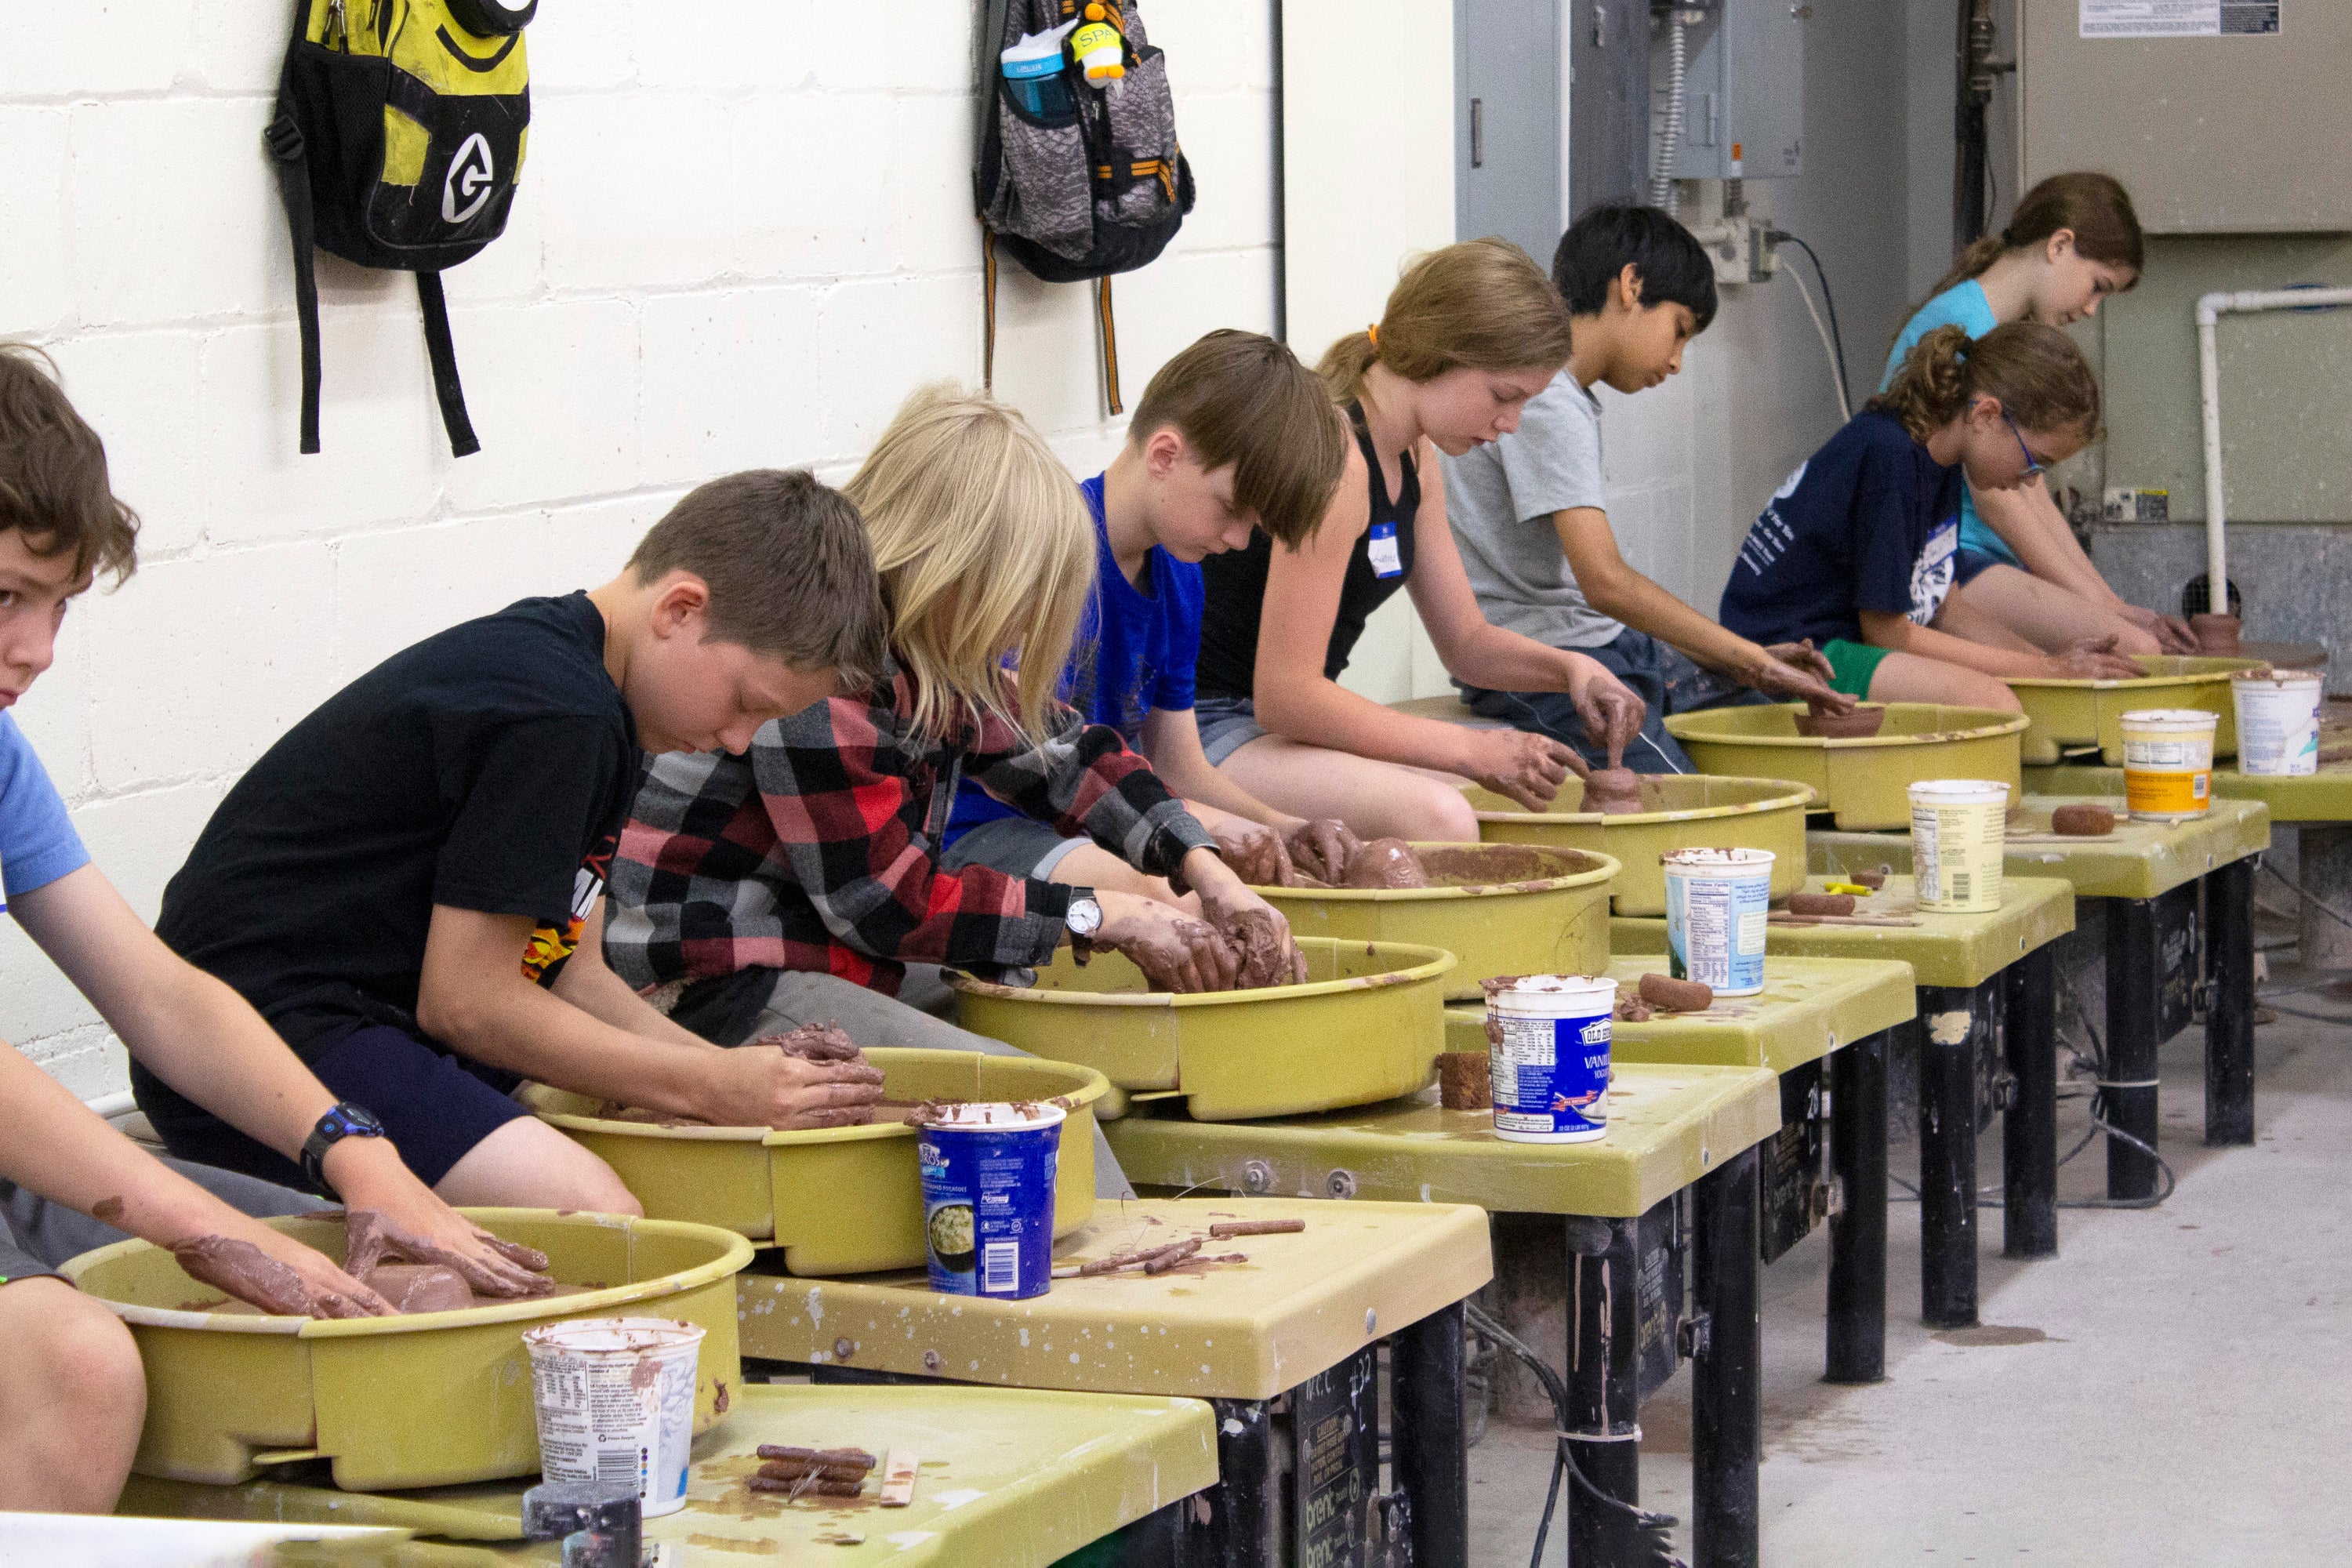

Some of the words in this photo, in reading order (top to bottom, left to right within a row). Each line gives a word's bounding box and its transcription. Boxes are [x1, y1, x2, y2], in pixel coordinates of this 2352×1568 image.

[1080, 28, 1117, 47] SPA
[1587, 1029, 1602, 1042] OLD
[1306, 1487, 1335, 1534] brent
[1306, 1534, 1334, 1568] brent
